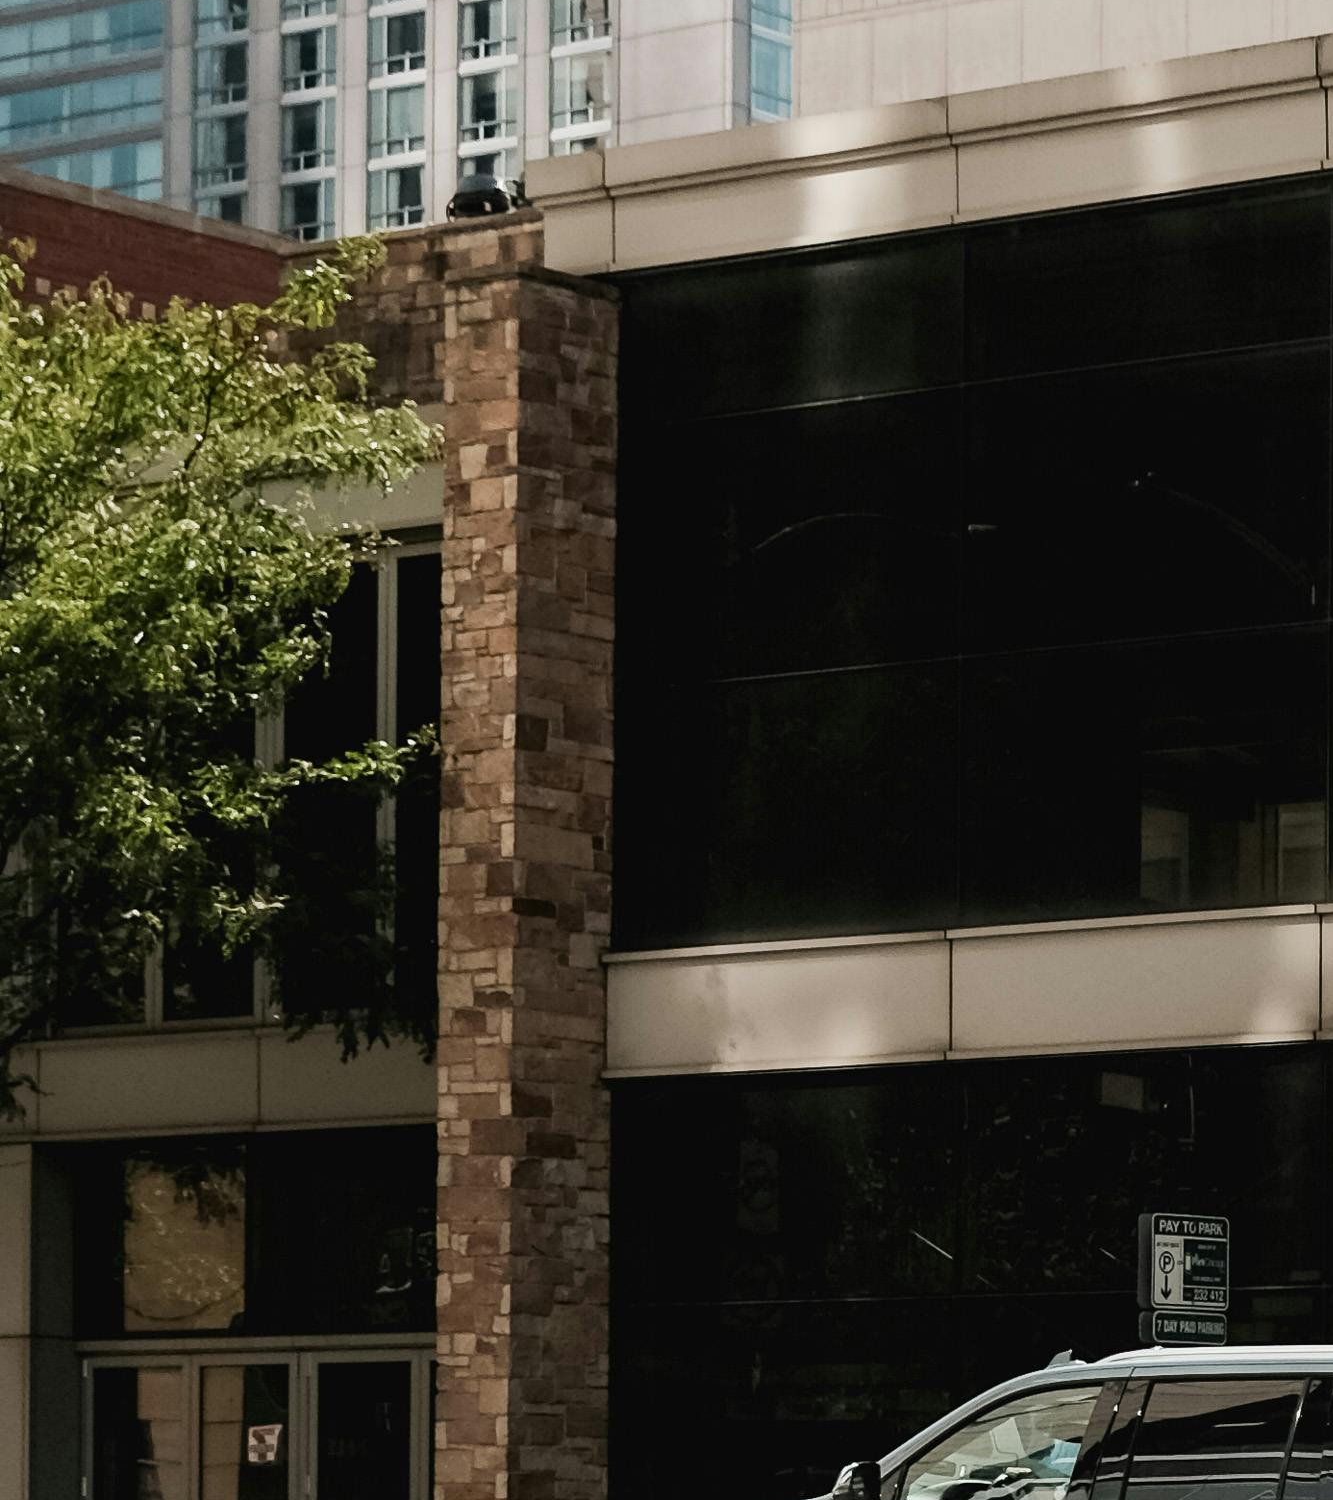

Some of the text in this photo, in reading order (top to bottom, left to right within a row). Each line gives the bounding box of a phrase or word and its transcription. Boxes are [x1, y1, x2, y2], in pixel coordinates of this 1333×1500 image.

[1159, 1219, 1224, 1236] PAY TO PARK
[1156, 1319, 1162, 1332] 7
[1163, 1319, 1178, 1333] DAY
